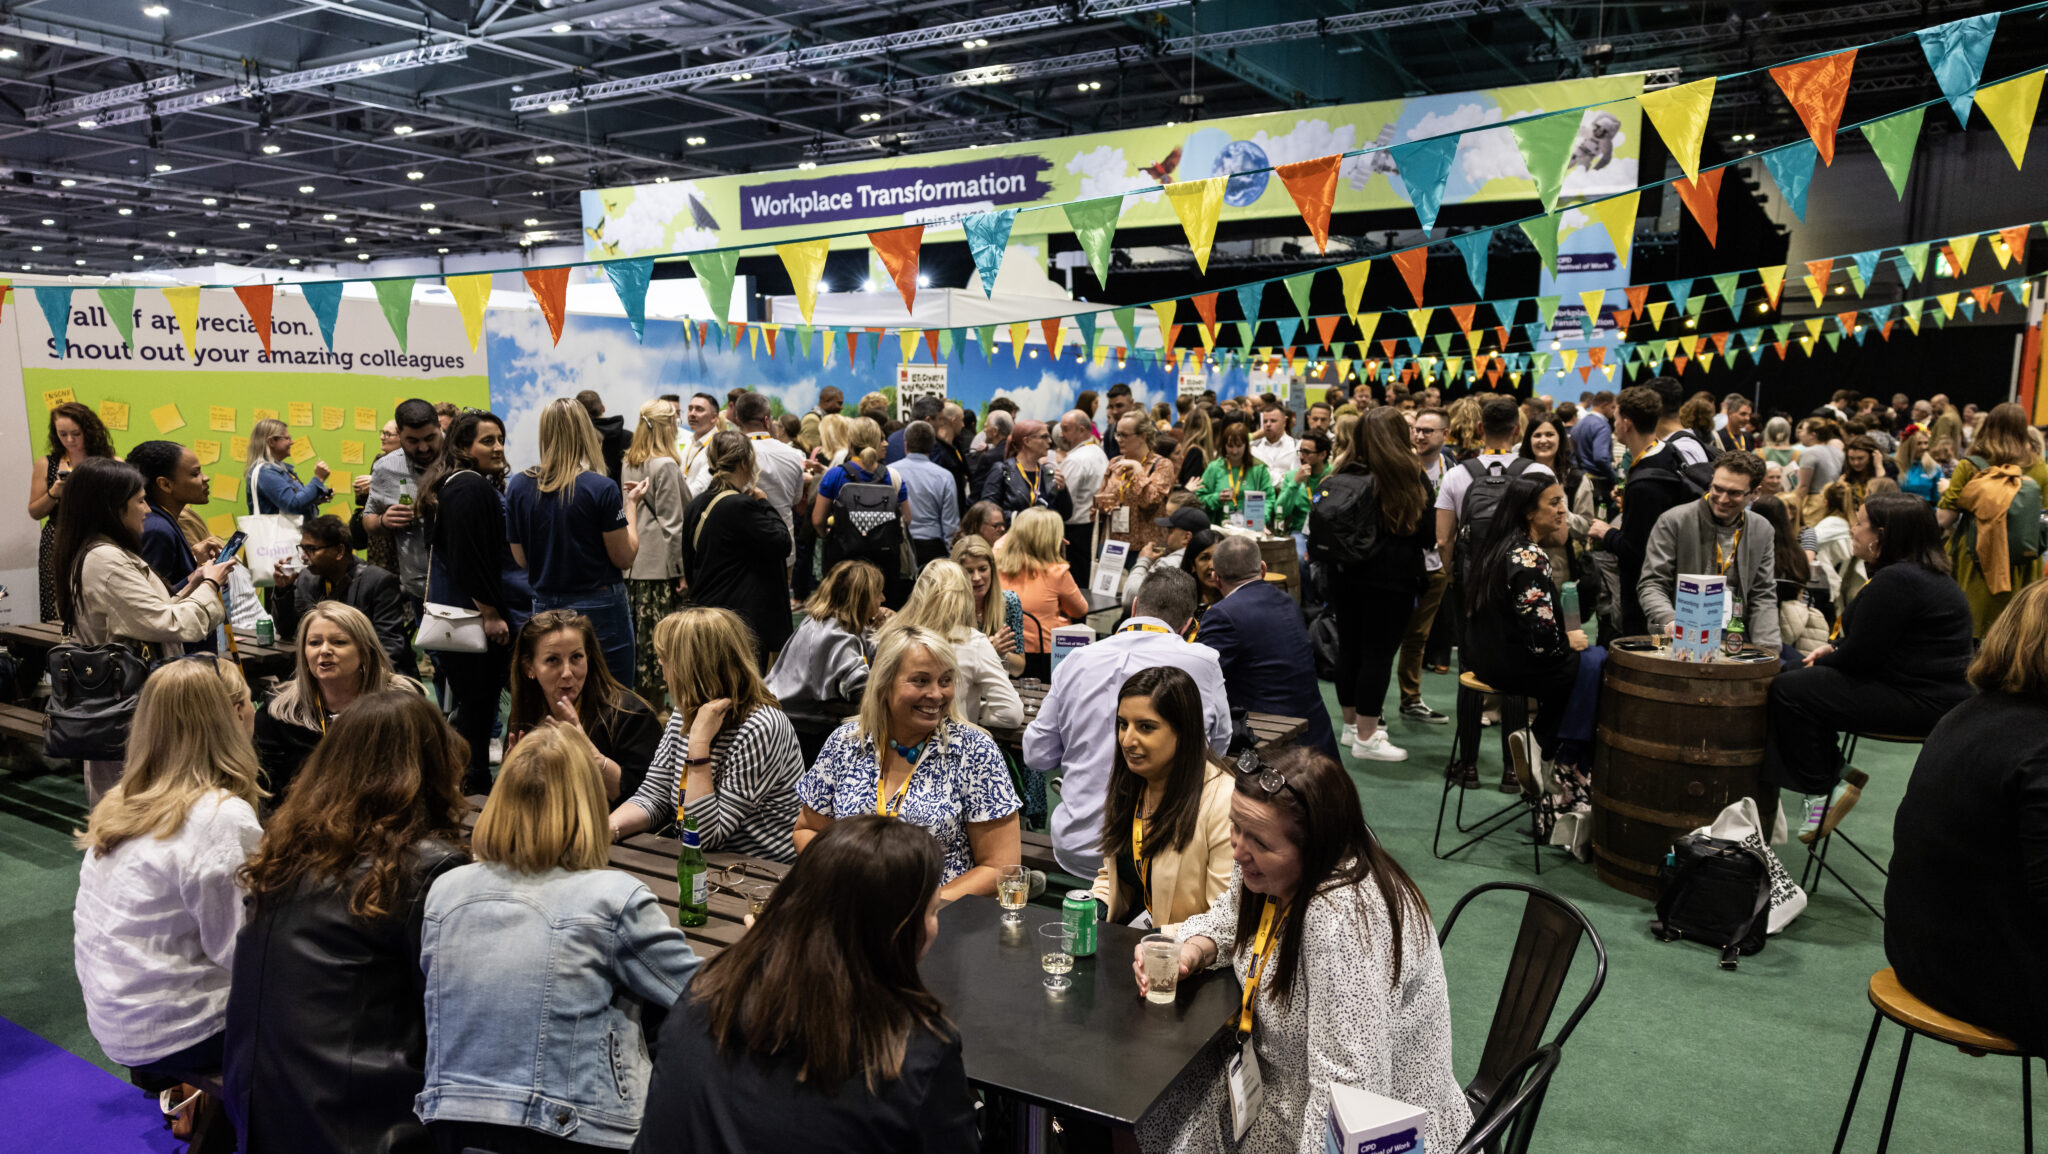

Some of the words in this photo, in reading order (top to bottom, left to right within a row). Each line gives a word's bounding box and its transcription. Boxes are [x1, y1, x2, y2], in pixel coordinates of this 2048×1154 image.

[750, 190, 853, 219] Workplace
[856, 172, 1027, 208] Transformation
[915, 214, 947, 229] Main
[66, 305, 107, 327] all
[151, 313, 313, 336] apreciaion.
[46, 337, 133, 361] Shout
[139, 343, 186, 362] out
[192, 349, 250, 367] your
[257, 346, 354, 370] amazing
[360, 349, 465, 372] colleagues
[1360, 1143, 1377, 1153] CIPD
[1386, 1146, 1394, 1154] of
[1394, 1141, 1411, 1152] Work
